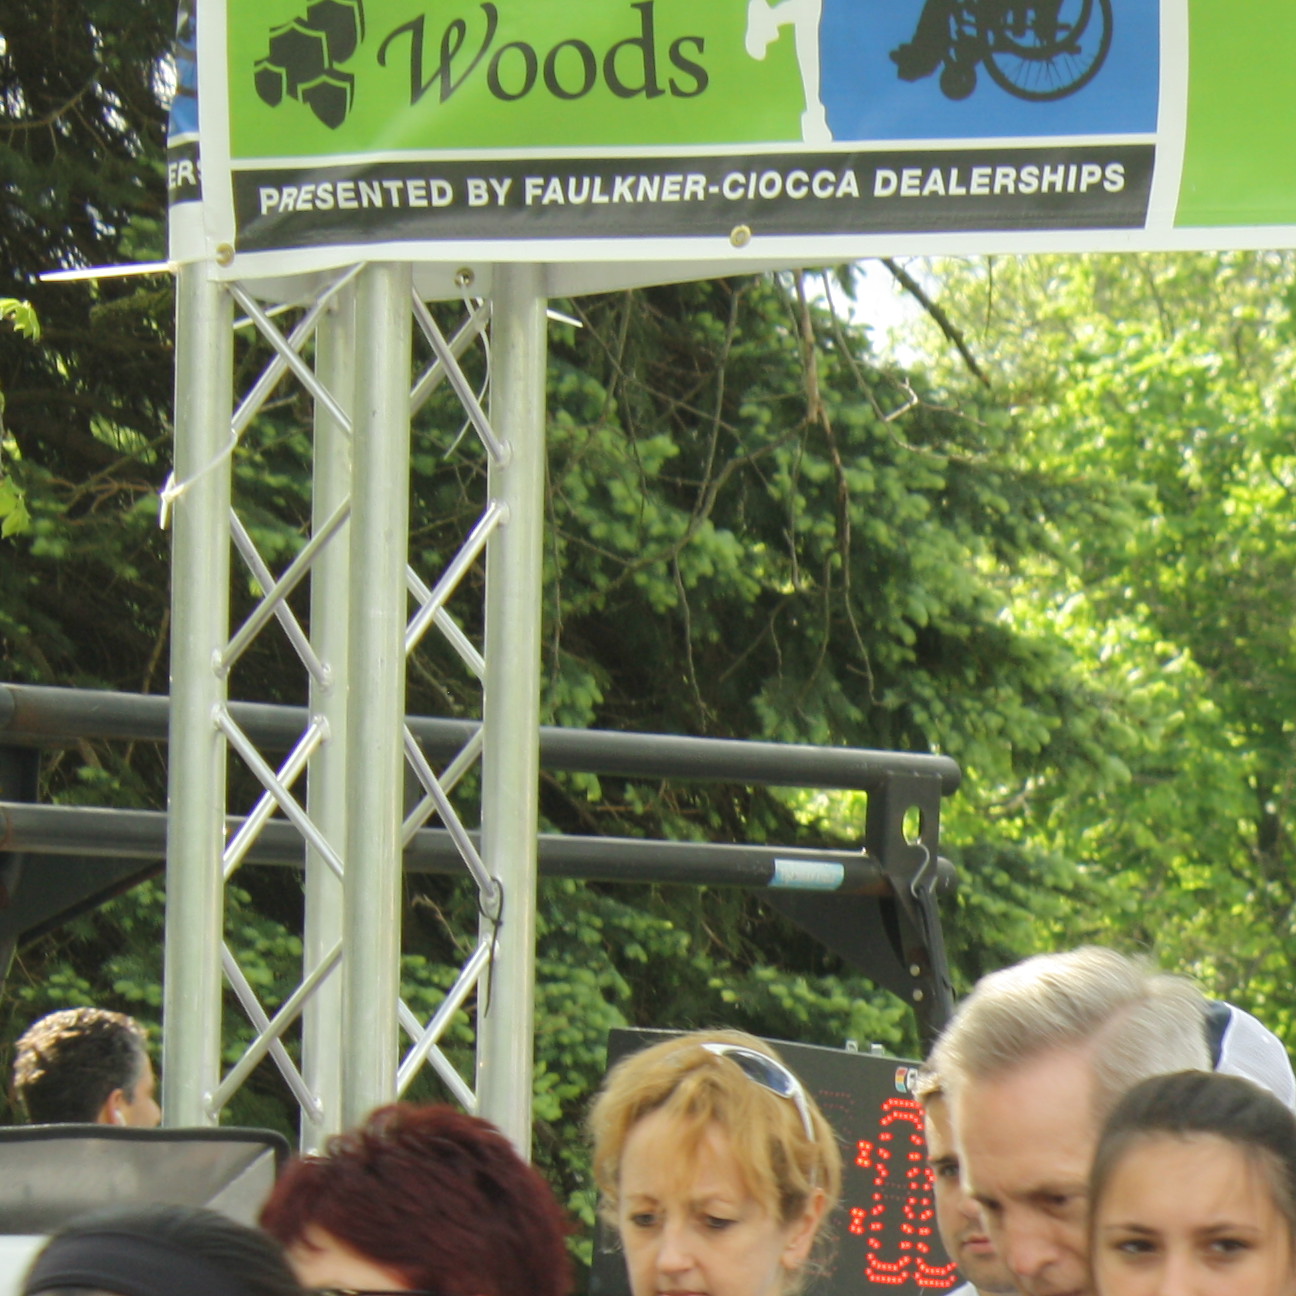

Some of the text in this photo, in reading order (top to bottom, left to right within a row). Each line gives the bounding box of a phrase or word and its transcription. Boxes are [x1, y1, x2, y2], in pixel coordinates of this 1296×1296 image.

[376, 0, 710, 107] Woods
[260, 162, 1126, 215] PRESENTED BY FAULKNER-CIOCCA DEALERSHIPS
